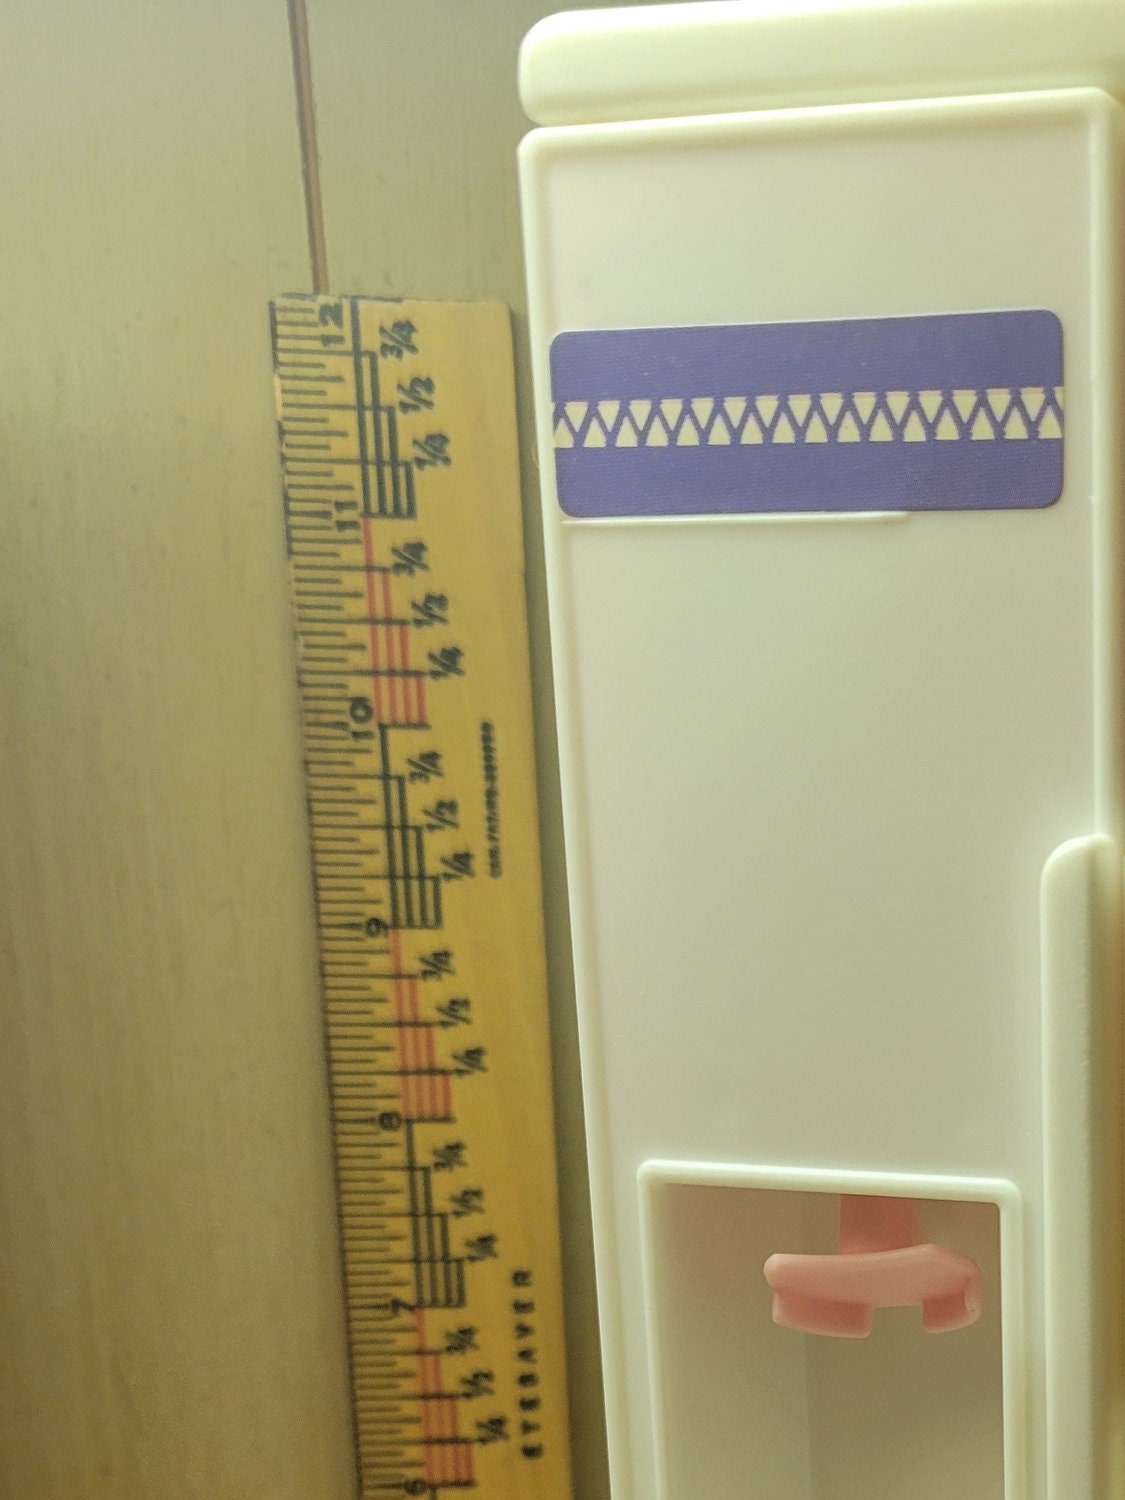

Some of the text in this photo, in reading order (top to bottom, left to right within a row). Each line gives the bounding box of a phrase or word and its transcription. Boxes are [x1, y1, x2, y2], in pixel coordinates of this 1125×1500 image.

[319, 303, 345, 346] 12
[334, 500, 360, 532] 11
[350, 697, 373, 741] 10
[365, 917, 388, 938] 9
